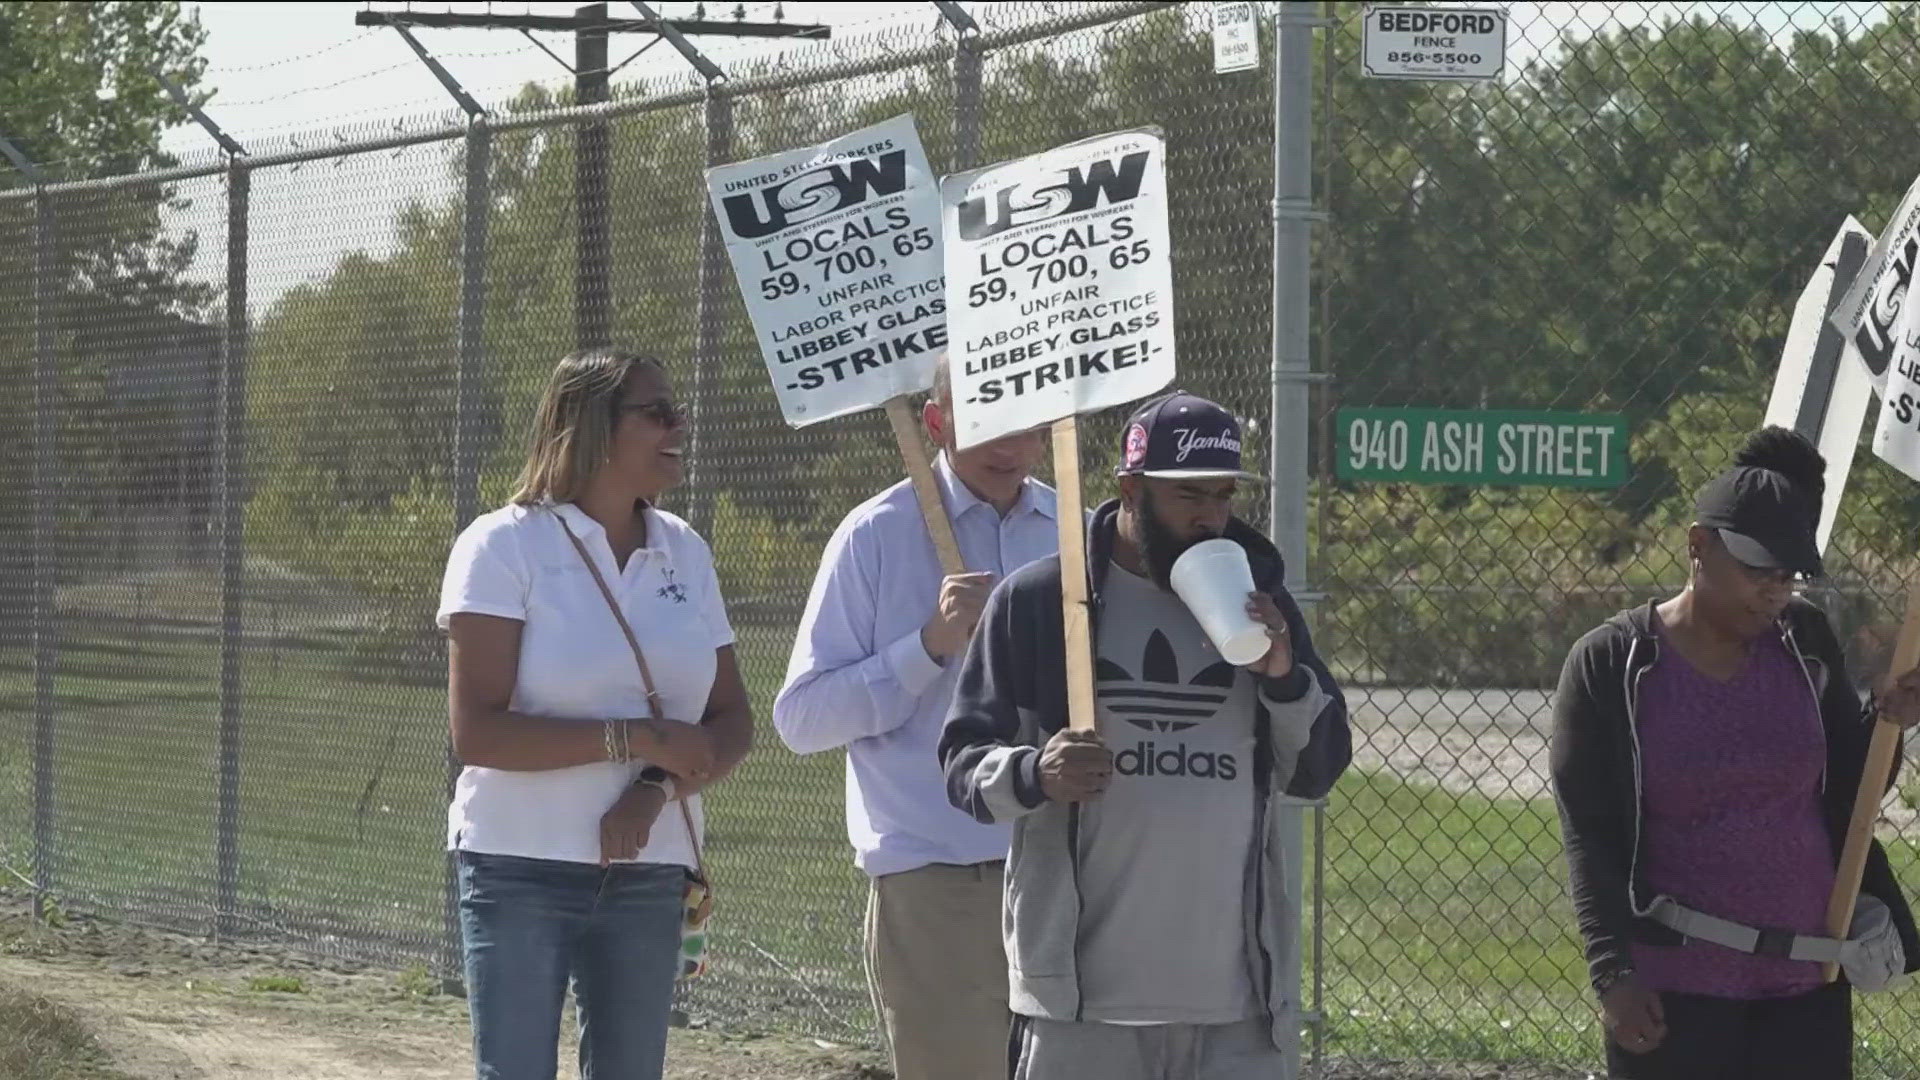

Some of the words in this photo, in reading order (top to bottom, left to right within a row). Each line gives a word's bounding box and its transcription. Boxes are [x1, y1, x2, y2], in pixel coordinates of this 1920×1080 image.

[1379, 12, 1495, 34] BEDFORD
[1413, 36, 1456, 48] FENCE
[1387, 52, 1482, 64] 856-5500
[722, 150, 906, 239] USW
[725, 173, 778, 192] UNITED
[755, 236, 780, 248] UNITY
[782, 229, 801, 238] AND
[845, 207, 862, 218] FOR
[763, 207, 911, 272] LOCALS
[980, 216, 1134, 276] LOCALS
[1071, 213, 1090, 223] FOR
[761, 271, 811, 300] 59,
[814, 245, 888, 282] 700,
[893, 227, 934, 257] 65
[818, 273, 895, 307] UNFAIR
[968, 277, 1016, 308] 59,
[1027, 254, 1098, 290] 700,
[1110, 240, 1151, 270] 65
[771, 311, 845, 343] LABOR
[966, 321, 1039, 354] LABOR
[1047, 290, 1158, 329] PRACTICE
[1020, 285, 1100, 317] UNFAIR
[776, 321, 869, 364] LIBBEY
[877, 298, 947, 330] GLAS
[786, 323, 949, 391] -STRIKE
[965, 333, 1061, 376] LIBBEY
[1070, 311, 1160, 345] GLASS
[966, 340, 1163, 405] -STRIKE!-
[1349, 418, 1408, 471] 940
[1421, 421, 1484, 473] ASH
[1497, 423, 1615, 477] STREET
[1114, 741, 1237, 781] didas
